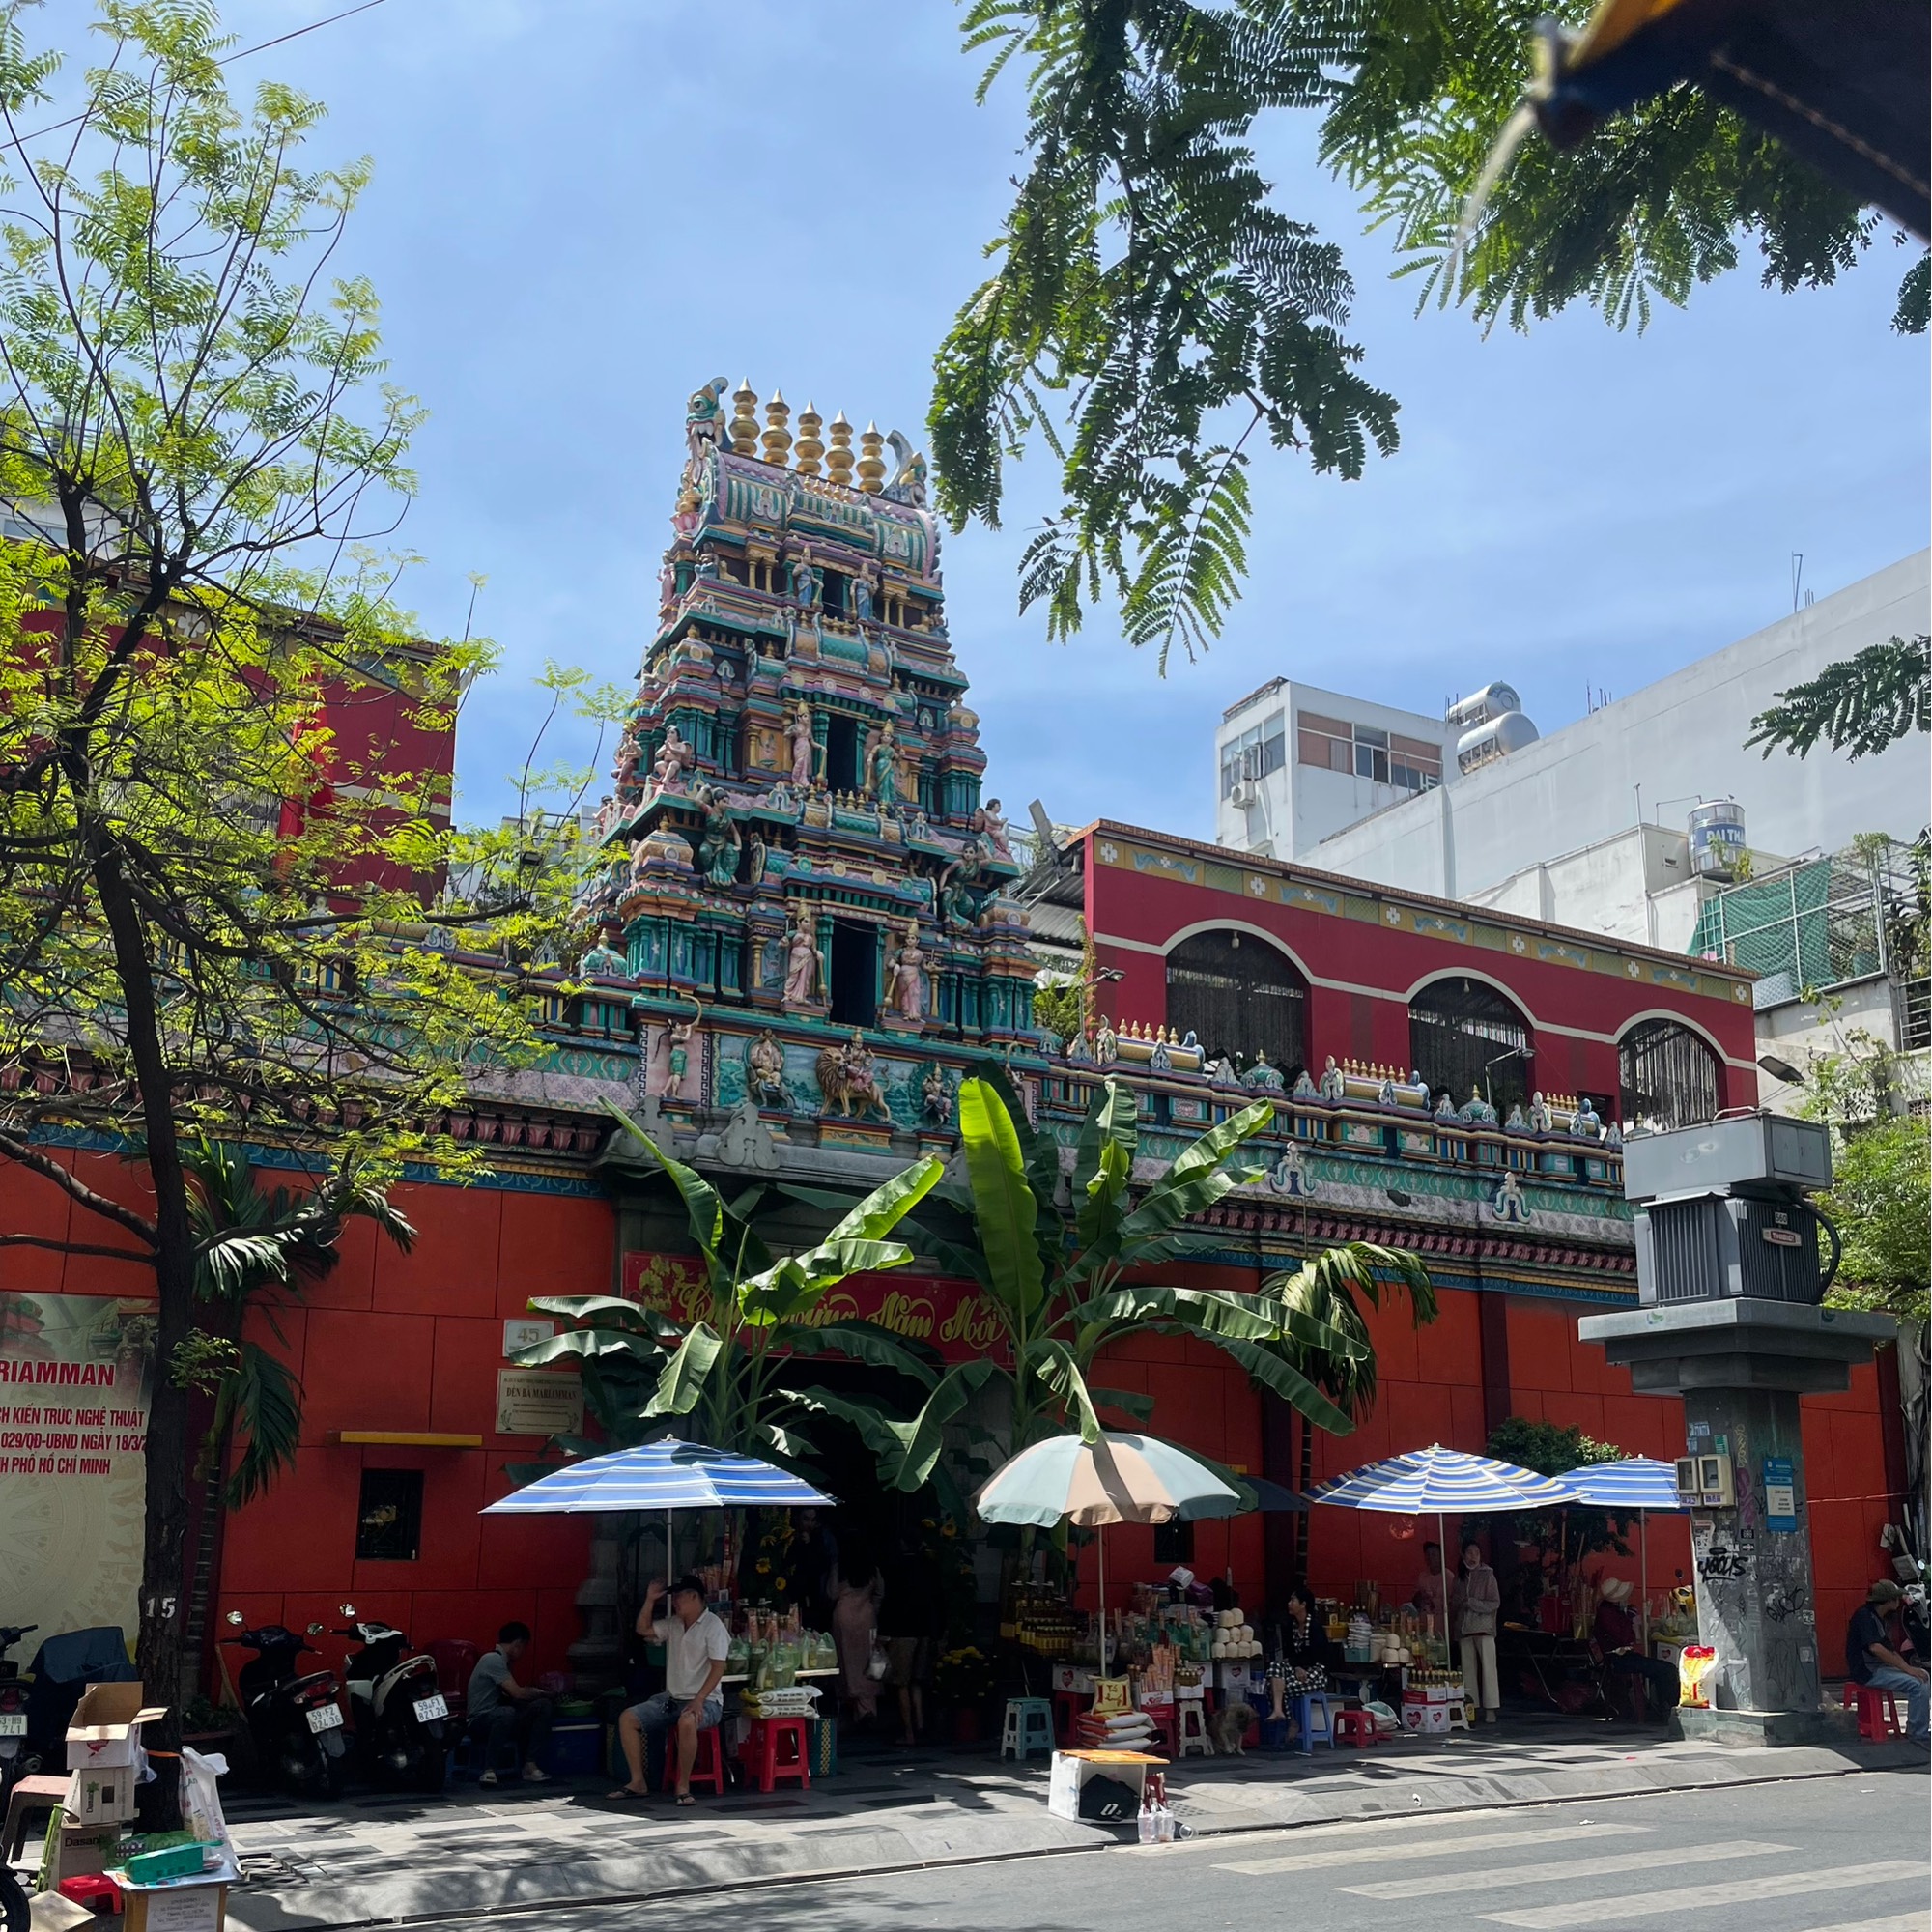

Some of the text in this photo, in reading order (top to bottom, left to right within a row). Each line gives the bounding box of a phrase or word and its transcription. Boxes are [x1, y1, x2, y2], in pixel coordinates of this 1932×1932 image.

[517, 1327, 540, 1343] 45
[13, 1402, 42, 1425] KIẾN
[43, 1405, 72, 1426] TRÚC
[75, 1406, 106, 1430] NGHỆ
[110, 1406, 145, 1431] THUẬT
[81, 1431, 113, 1451] NGÀY
[12, 1451, 37, 1473] PHỐ
[58, 1454, 78, 1474] CHÍ
[79, 1458, 111, 1475] MINH
[146, 1597, 176, 1619] 15
[0, 1716, 22, 1725] 3-H9
[418, 1705, 446, 1720] 821.26
